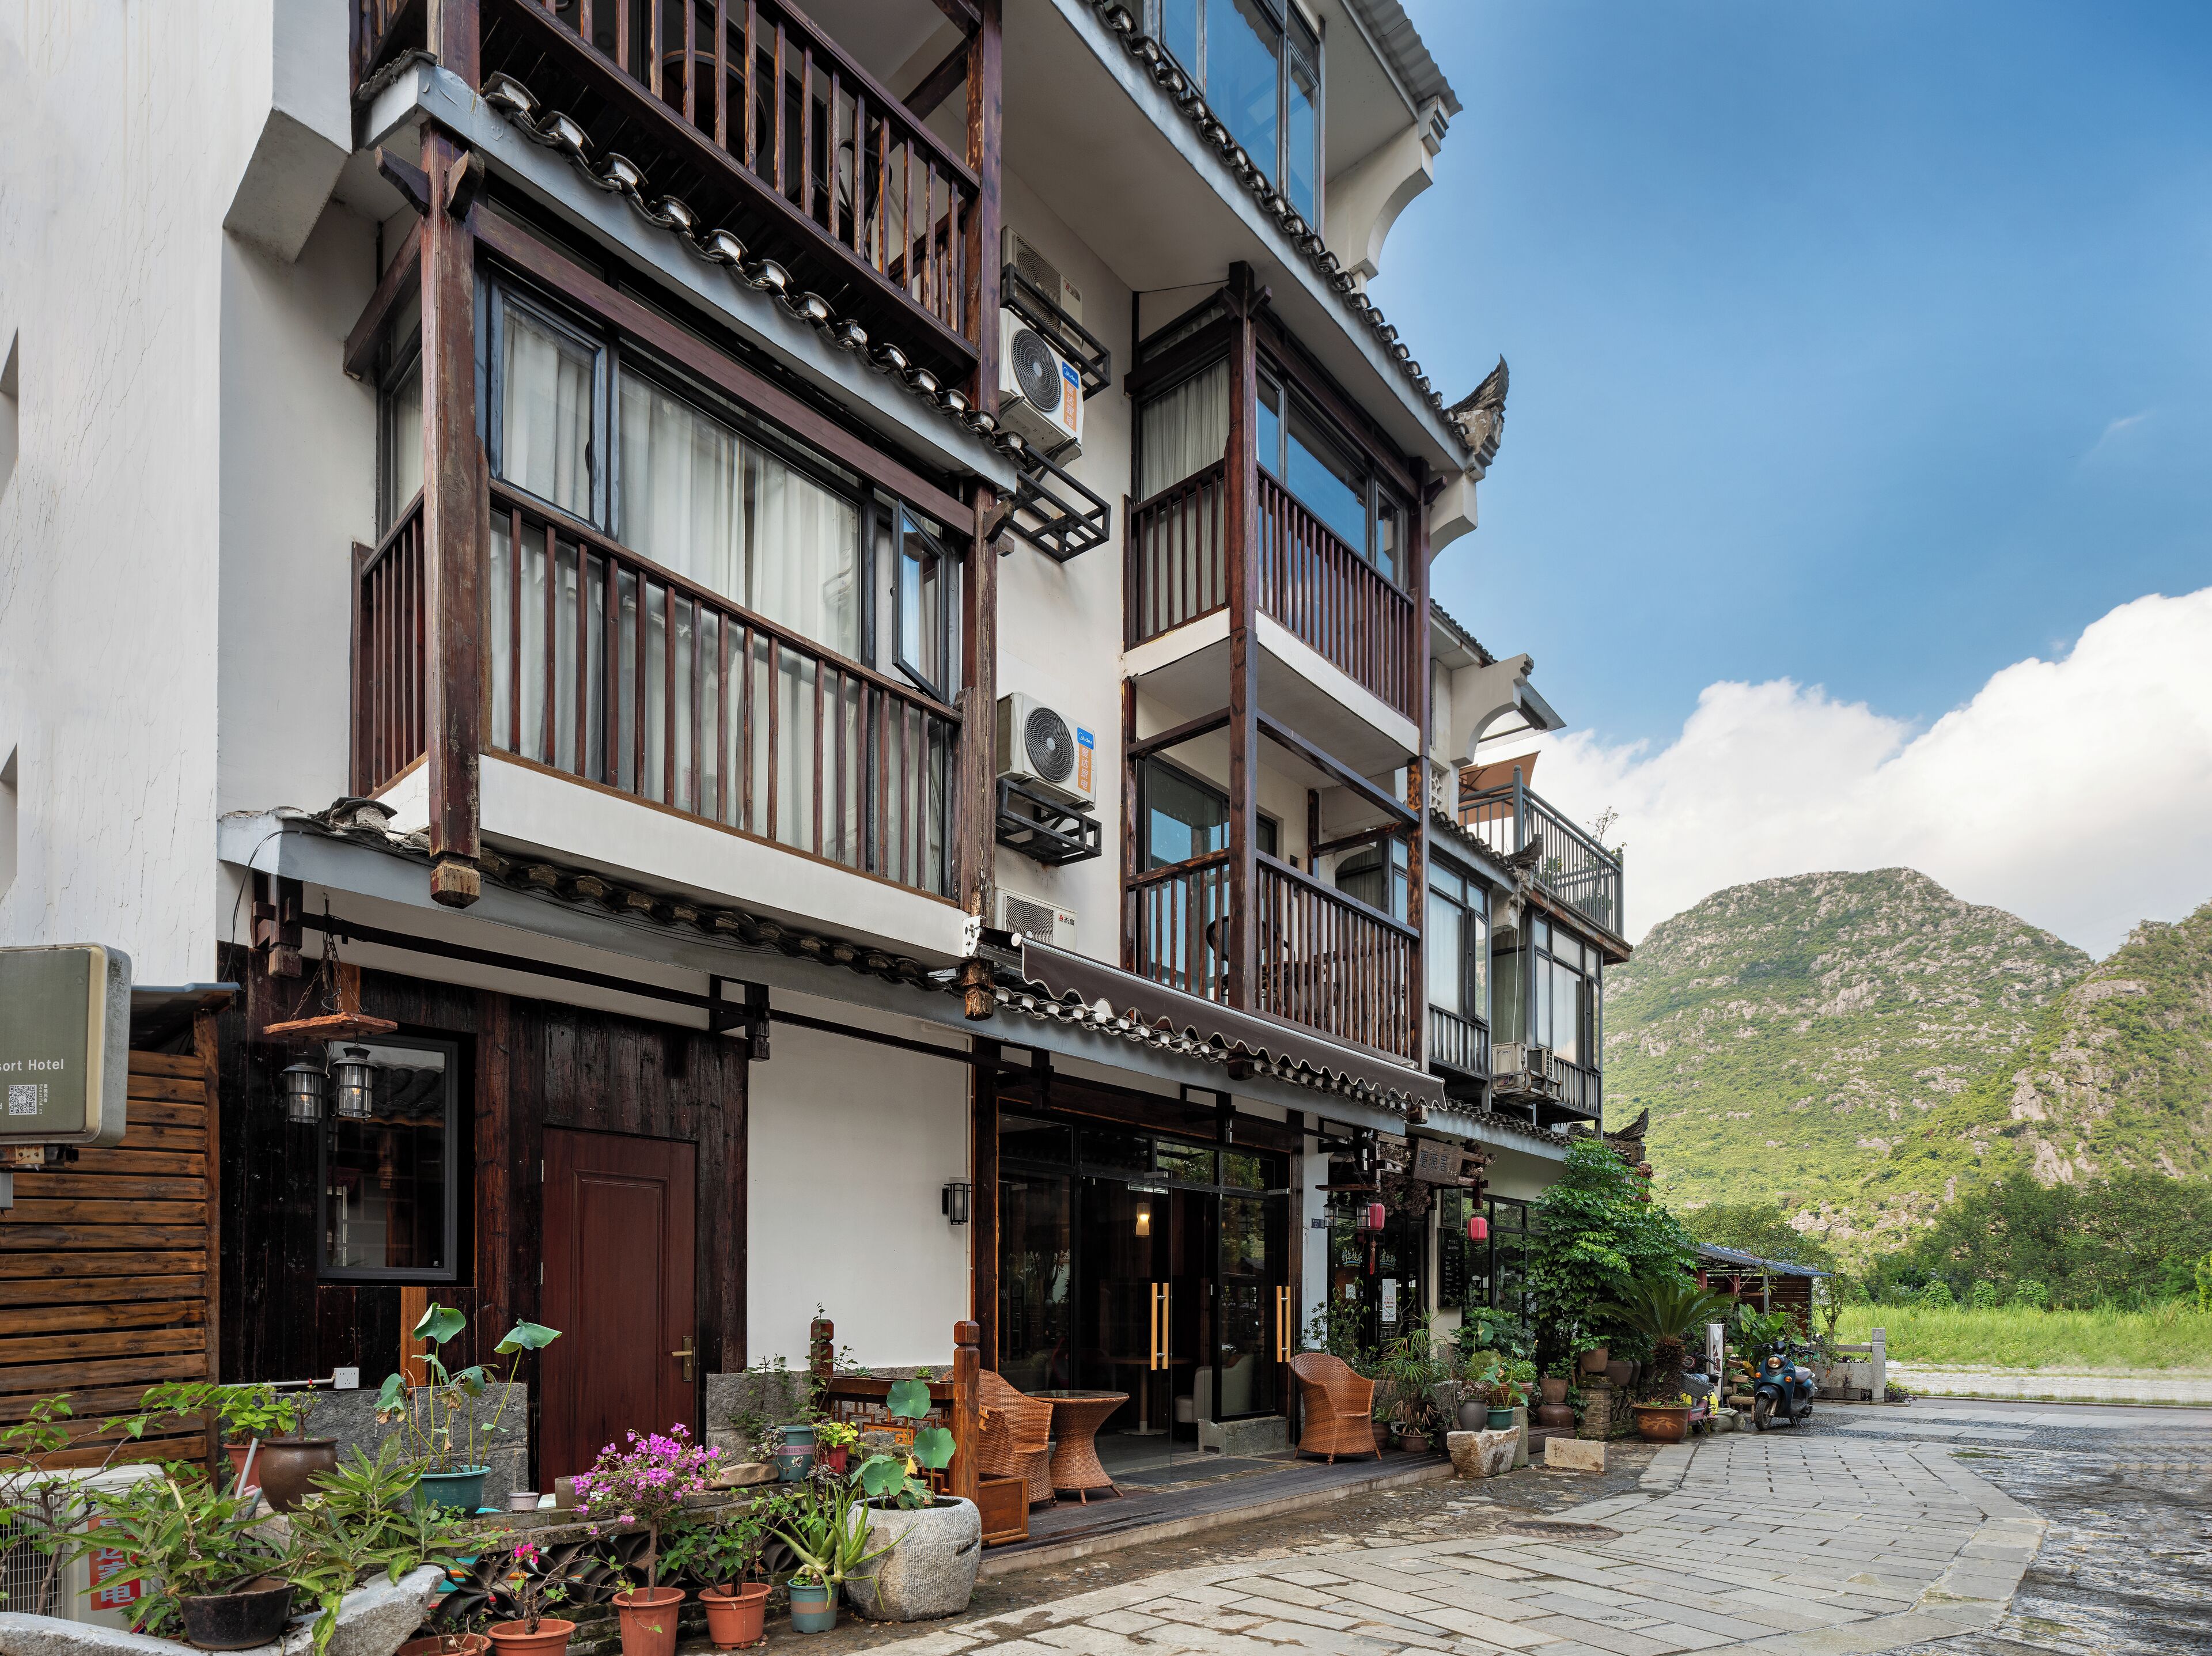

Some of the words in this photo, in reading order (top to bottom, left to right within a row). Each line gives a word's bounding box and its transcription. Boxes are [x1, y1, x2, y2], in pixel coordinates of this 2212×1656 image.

[1063, 366, 1078, 384] Midea
[1078, 732, 1093, 745] Midea
[0, 1060, 22, 1071] ort
[28, 1059, 64, 1071] Hotel
